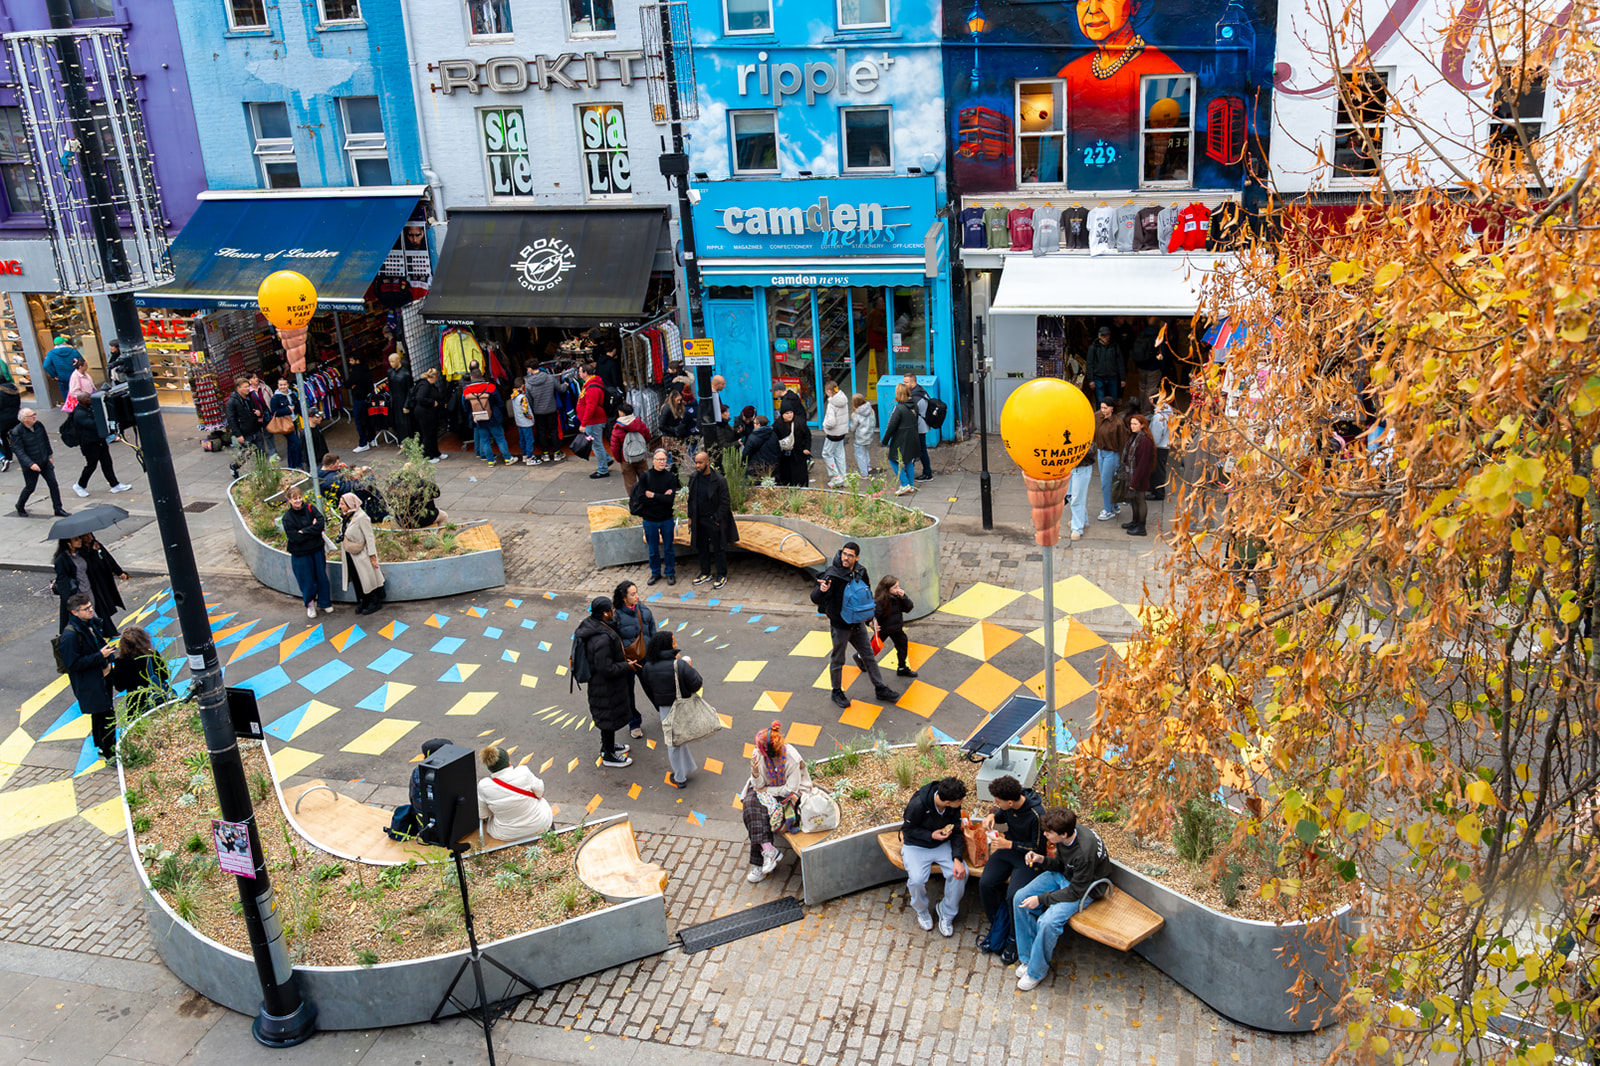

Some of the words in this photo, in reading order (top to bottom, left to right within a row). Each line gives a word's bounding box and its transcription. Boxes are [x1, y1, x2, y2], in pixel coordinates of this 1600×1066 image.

[438, 50, 643, 95] ROKIT
[1084, 146, 1116, 164] 229
[723, 195, 883, 235] camden
[1118, 212, 1137, 224] LONDO
[821, 225, 897, 247] news
[214, 247, 262, 259] House
[263, 249, 287, 261] of
[282, 248, 341, 258] Leather
[519, 238, 576, 260] ROKIT
[517, 275, 563, 292] LONDON
[770, 274, 817, 286] camden
[818, 276, 850, 286] news
[1033, 448, 1048, 458] ST
[1041, 452, 1086, 467] GARDENS
